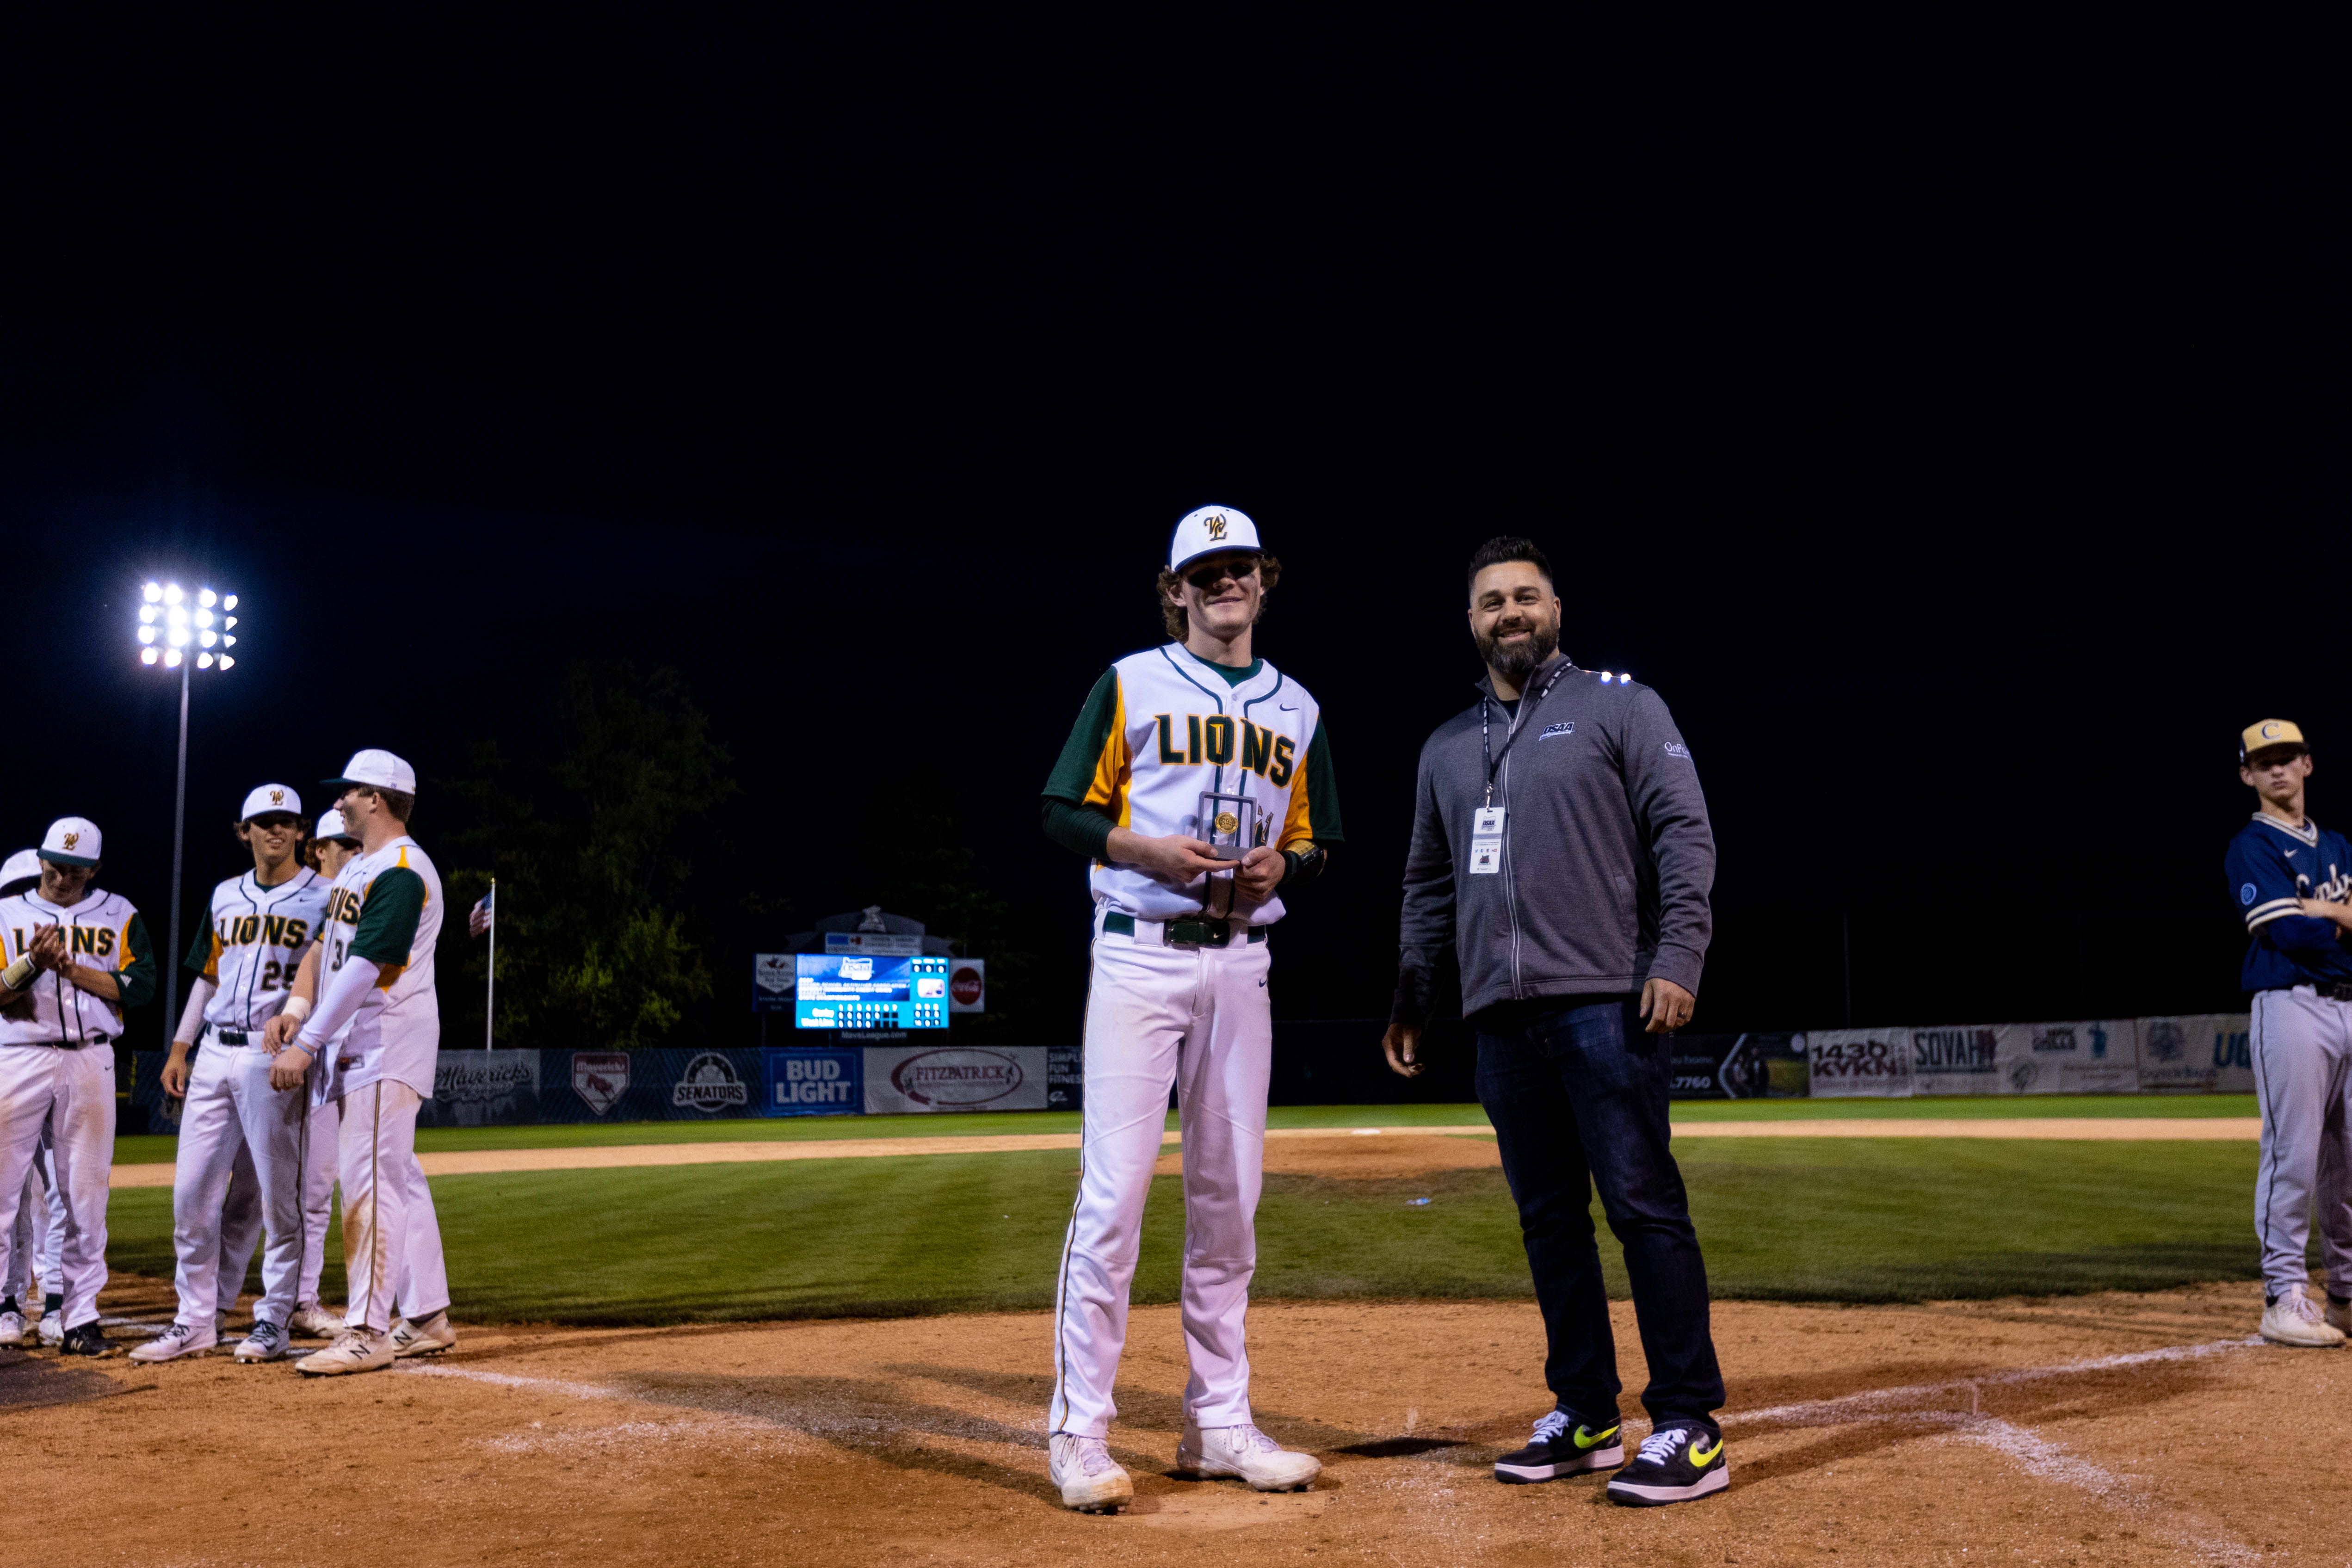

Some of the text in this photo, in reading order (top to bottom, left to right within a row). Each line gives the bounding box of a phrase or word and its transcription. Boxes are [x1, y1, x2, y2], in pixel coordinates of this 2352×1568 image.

[1543, 722, 1574, 734] OSAA
[2260, 722, 2281, 740] C
[1154, 712, 1297, 790] LIONS
[12, 924, 117, 957] LONS
[219, 914, 309, 949] LIONS
[260, 961, 299, 992] 25
[1049, 1052, 1082, 1062] SIMPL
[786, 1059, 841, 1081] BUD
[915, 1066, 1004, 1080] FITZPATRICK
[1813, 1059, 1896, 1076] KYKN
[1049, 1074, 1082, 1084] FITNES
[677, 1086, 743, 1101] SENATORS
[775, 1081, 851, 1103] LIGHT
